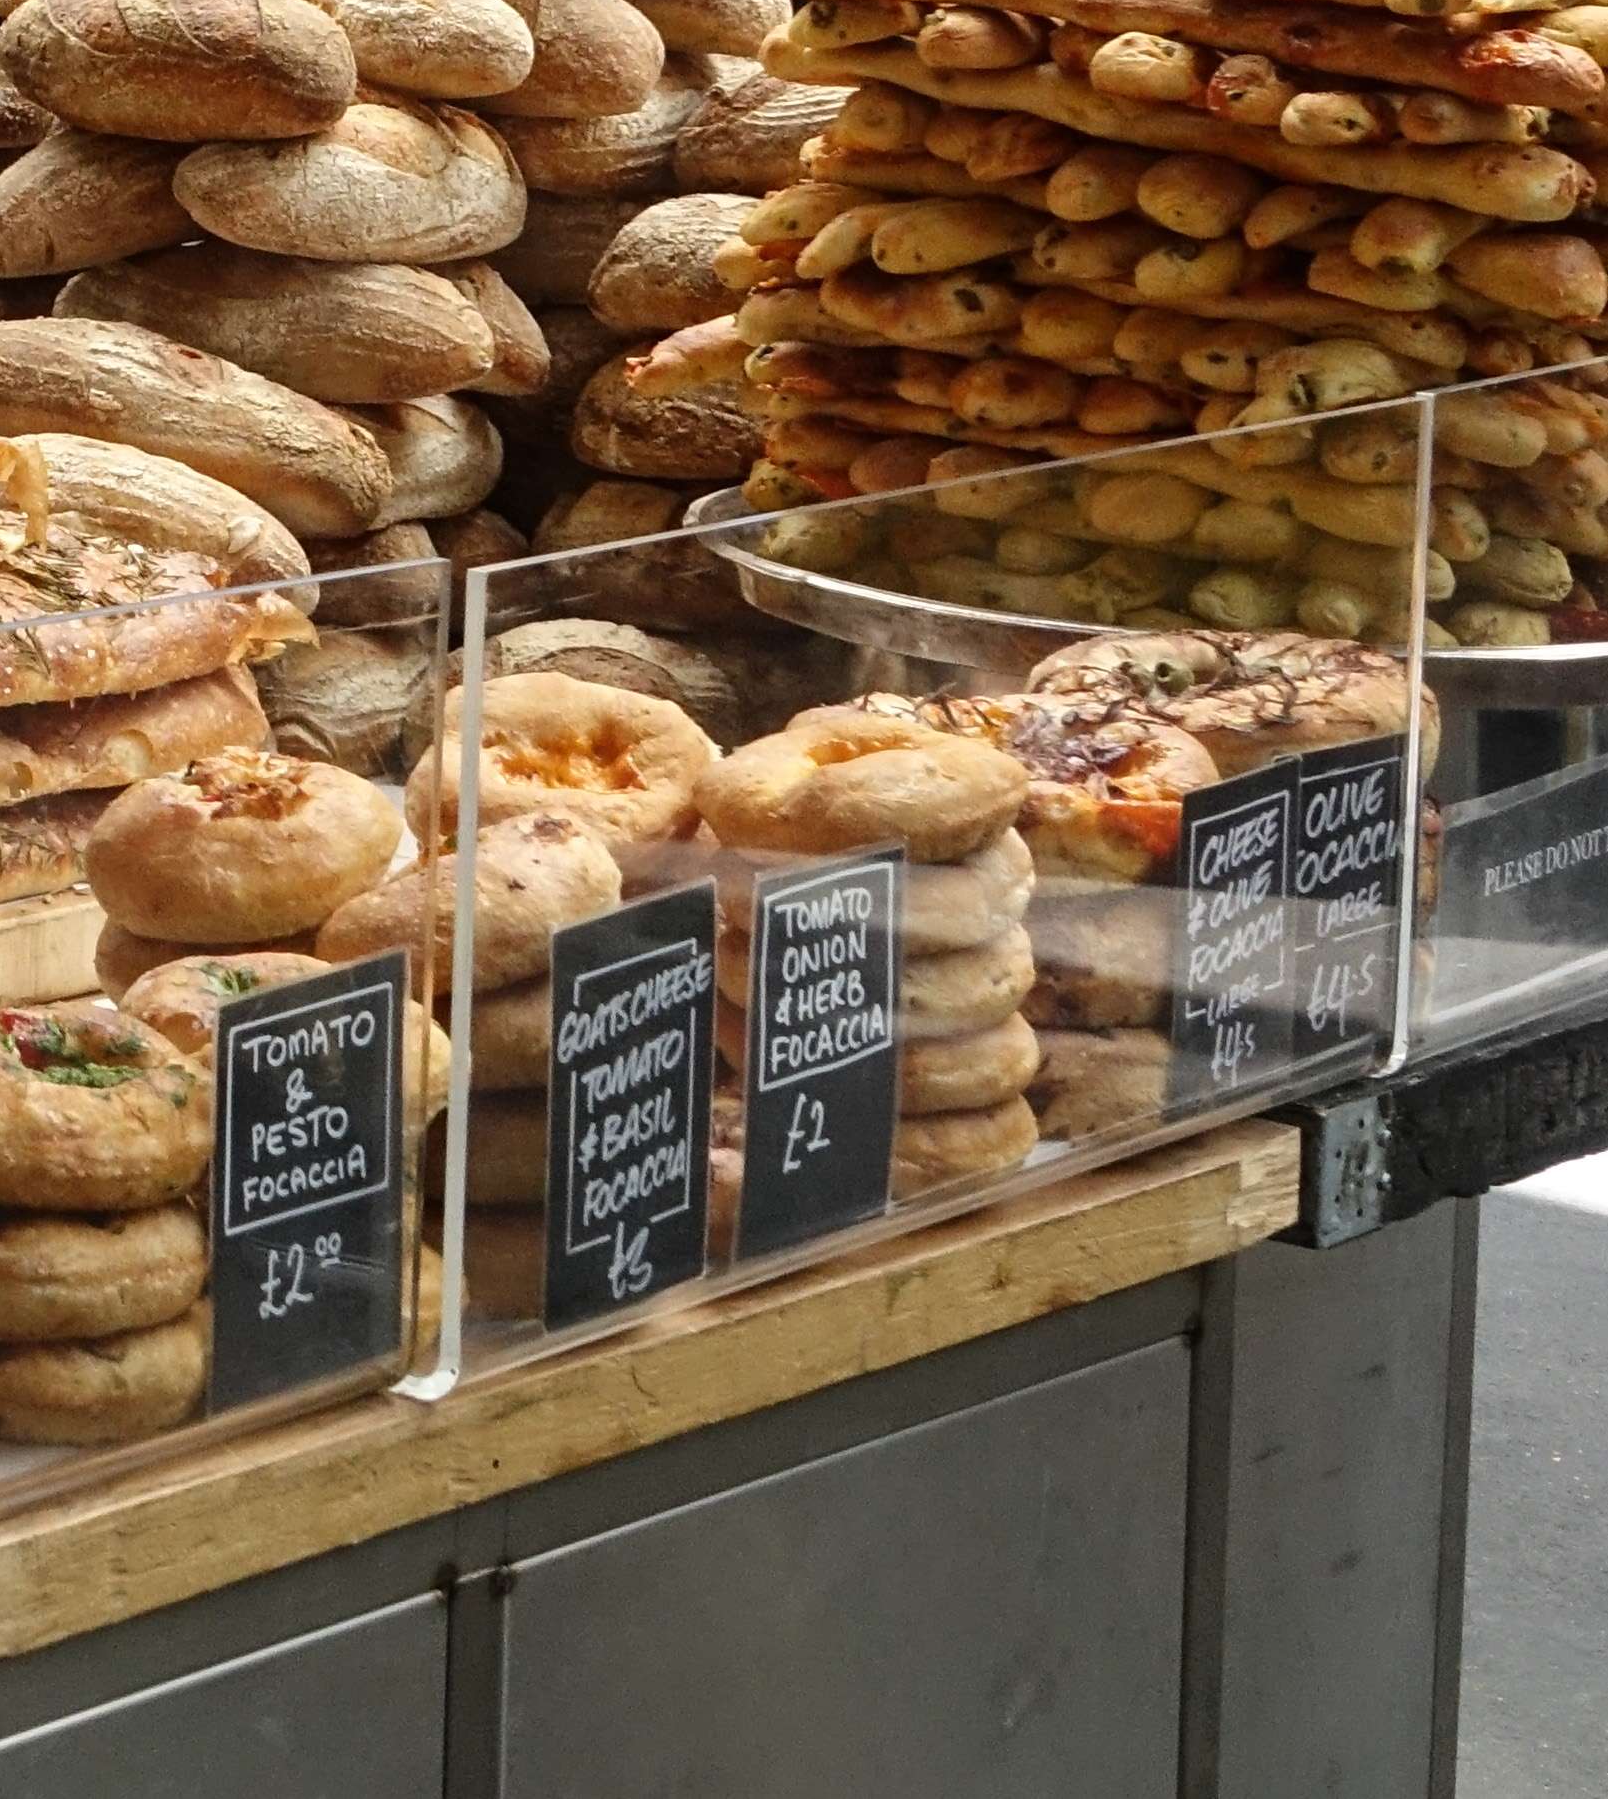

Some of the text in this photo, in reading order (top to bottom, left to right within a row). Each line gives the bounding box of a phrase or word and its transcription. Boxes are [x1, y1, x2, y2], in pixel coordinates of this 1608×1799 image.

[1305, 768, 1385, 839] OLIVE
[1199, 807, 1281, 885] CHEESE
[1296, 819, 1403, 895] OCACCI
[1484, 849, 1543, 897] PLEASE
[1545, 840, 1568, 875] DO
[1570, 827, 1604, 866] NOT
[775, 887, 872, 939] TOMATO
[1209, 859, 1276, 929] OLIVE
[1317, 881, 1383, 938] LARGE
[783, 922, 868, 984] ONION
[1188, 905, 1285, 991] FOCACCIA
[798, 970, 865, 1024] HERB
[242, 1010, 376, 1074] TOMATO
[581, 1029, 684, 1114] TOMATO
[771, 1003, 884, 1075] FOCACCIA
[285, 1068, 312, 1113] &
[601, 1087, 676, 1162] BASIL
[252, 1105, 349, 1162] PESTO
[783, 1093, 830, 1174] £2
[243, 1145, 367, 1212] FOCACCIA
[583, 1138, 687, 1227] FOCACCIA
